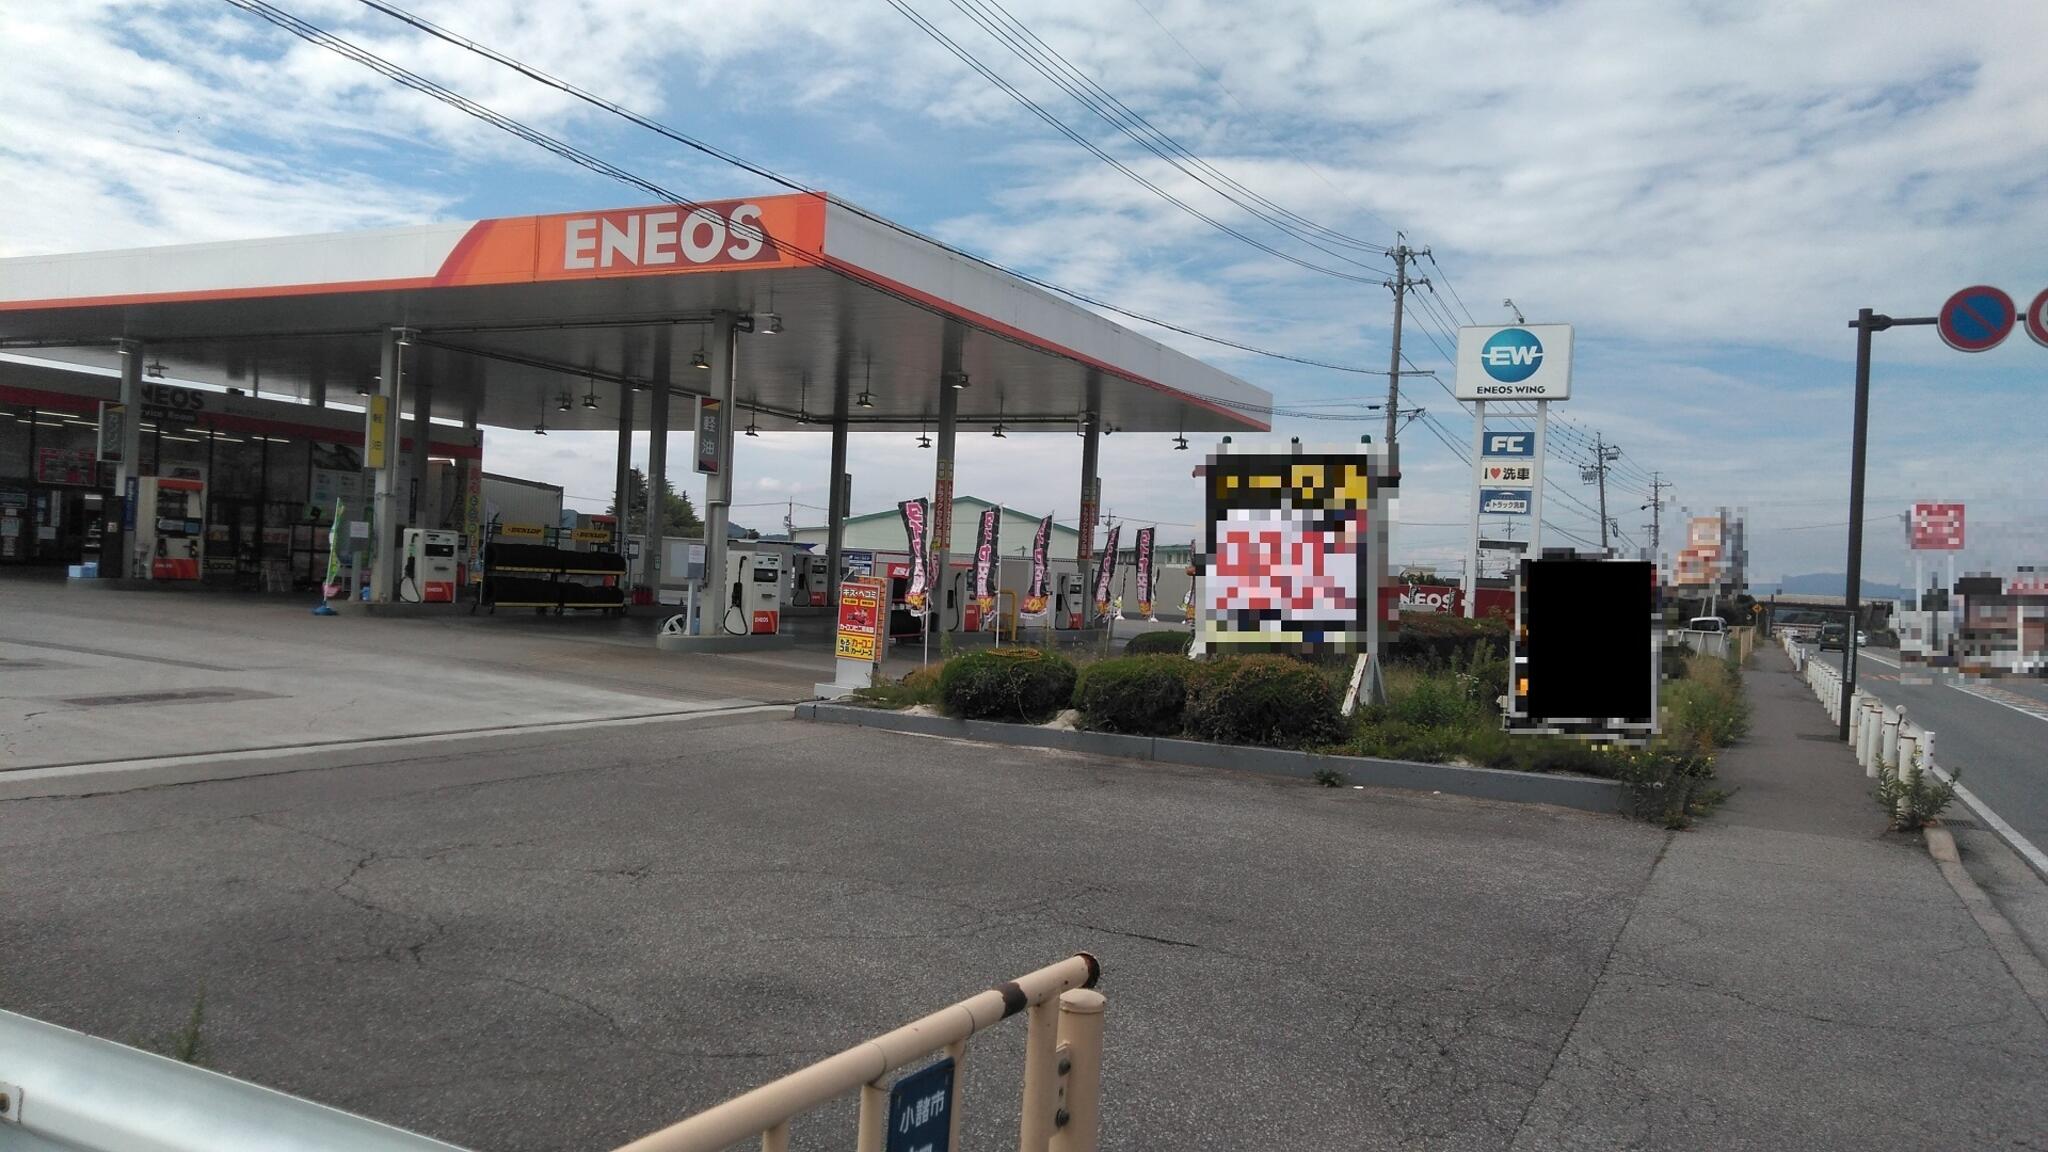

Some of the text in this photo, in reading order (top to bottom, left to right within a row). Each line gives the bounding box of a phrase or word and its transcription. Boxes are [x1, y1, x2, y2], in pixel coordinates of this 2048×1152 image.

[564, 204, 764, 270] ENEOS
[1489, 346, 1537, 365] EW
[141, 384, 204, 409] NEOS
[1476, 386, 1546, 395] ENEOS WING
[702, 415, 716, 455] 軽油
[1491, 436, 1525, 452] FC
[1503, 467, 1530, 480] 洗車
[512, 527, 541, 535] DUNLOP
[1400, 592, 1452, 609] NEOS
[899, 1090, 945, 1134] 小諸市
